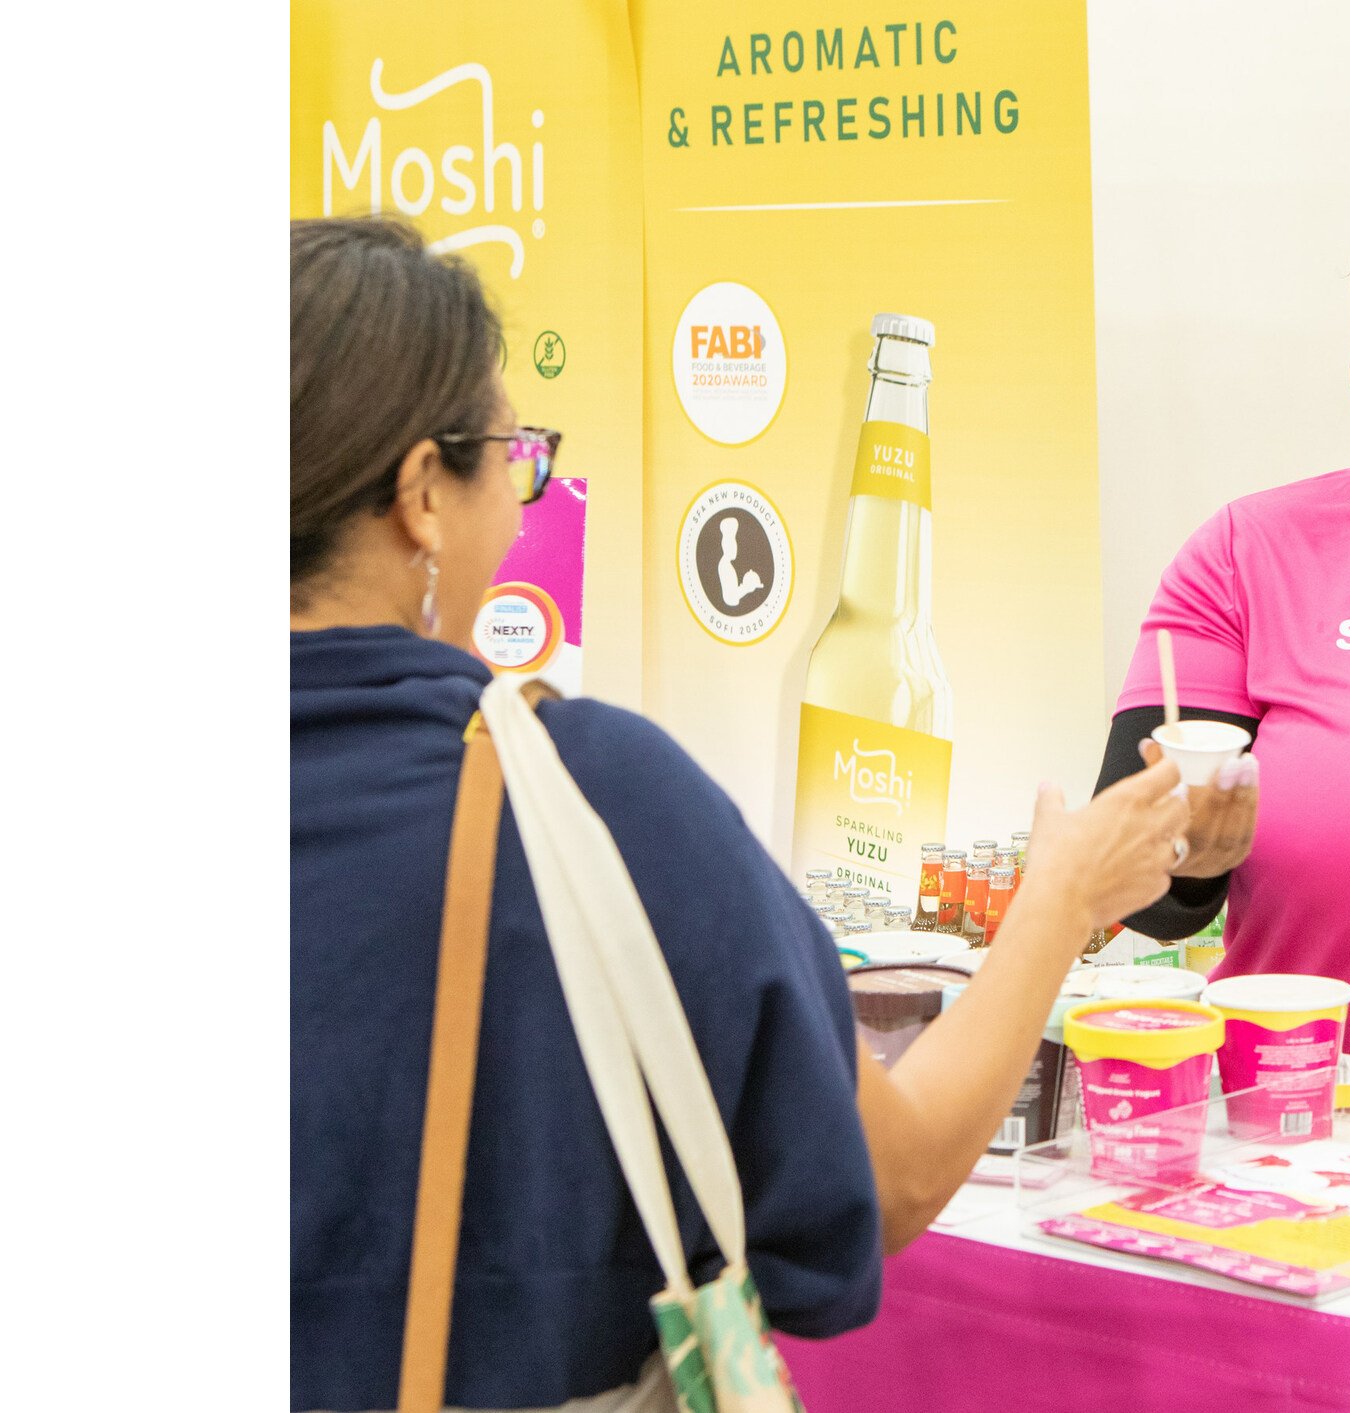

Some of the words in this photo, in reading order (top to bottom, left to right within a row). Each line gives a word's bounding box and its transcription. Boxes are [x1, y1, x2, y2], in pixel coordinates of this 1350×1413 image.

[717, 19, 959, 77] AROMATIC
[668, 107, 690, 148] &
[711, 89, 1021, 147] REFRESHING
[322, 60, 545, 218] Moshi
[691, 325, 762, 359] FABI
[691, 362, 714, 372] FOOD
[716, 363, 721, 371] &
[722, 362, 767, 372] BEVERAGE
[692, 373, 722, 386] 2020
[722, 374, 768, 387] AWARD
[873, 444, 914, 468] YUZU
[870, 464, 916, 483] ORIGINAL
[692, 506, 707, 524] SFA
[708, 490, 728, 505] NEW
[733, 490, 776, 528] PRODUCT
[492, 626, 534, 636] NEXTY
[709, 615, 733, 634] SOFI
[739, 620, 764, 635] 2020
[834, 740, 913, 802] Moshi
[836, 814, 903, 844] SPARKLING
[847, 836, 888, 862] YUZU
[836, 866, 893, 893] ORIGINAL
